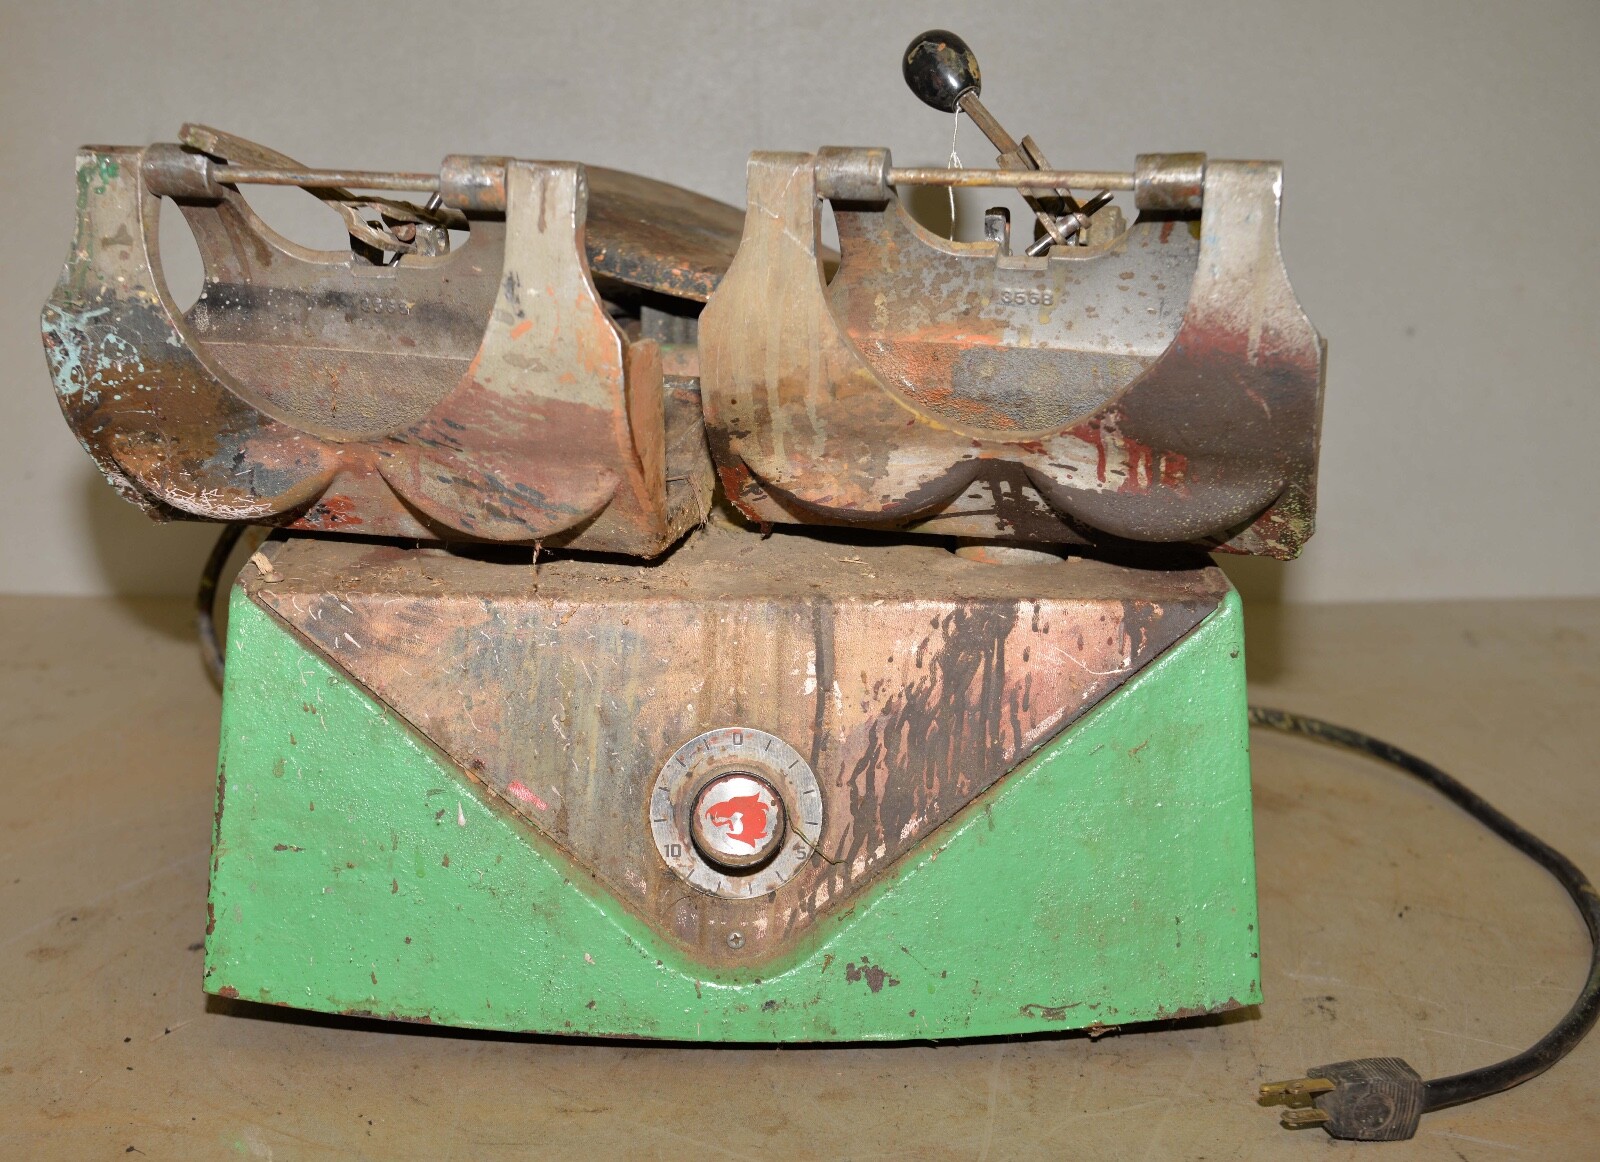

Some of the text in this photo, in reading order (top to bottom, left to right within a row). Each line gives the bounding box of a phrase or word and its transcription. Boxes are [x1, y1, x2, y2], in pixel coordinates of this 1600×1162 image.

[733, 732, 743, 746] 0
[664, 843, 682, 858] 10
[796, 846, 807, 861] 5
